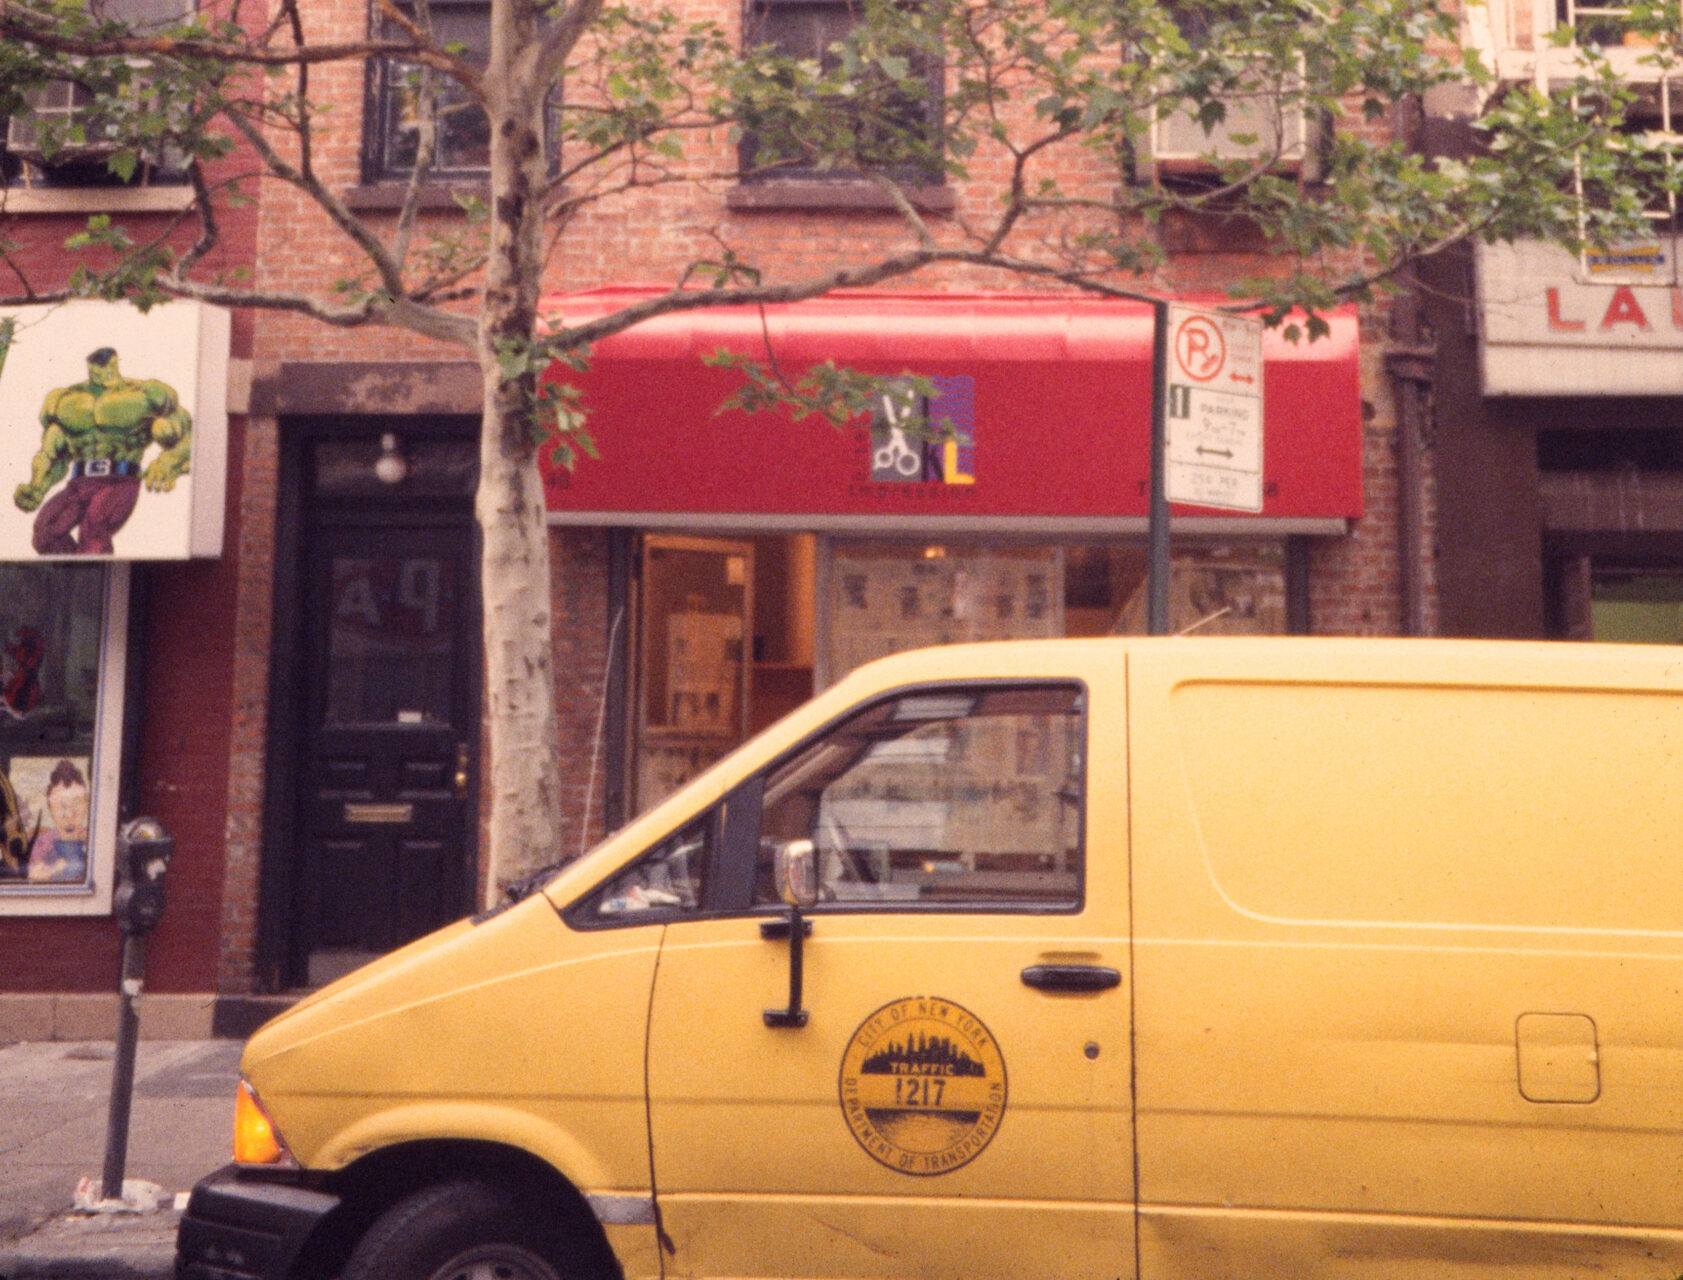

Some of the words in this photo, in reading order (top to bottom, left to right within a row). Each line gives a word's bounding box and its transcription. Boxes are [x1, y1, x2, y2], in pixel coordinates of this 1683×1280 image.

[1201, 402, 1249, 421] PARKING
[857, 1018, 885, 1049] CITY
[891, 1004, 907, 1021] OF
[919, 1002, 949, 1018] NEW
[958, 1014, 988, 1048] YORK
[896, 1077, 947, 1106] 1217
[845, 1077, 893, 1156] DEPARTMENT
[899, 1154, 917, 1170] OF
[923, 1081, 1002, 1171] TRANSPORTATION
